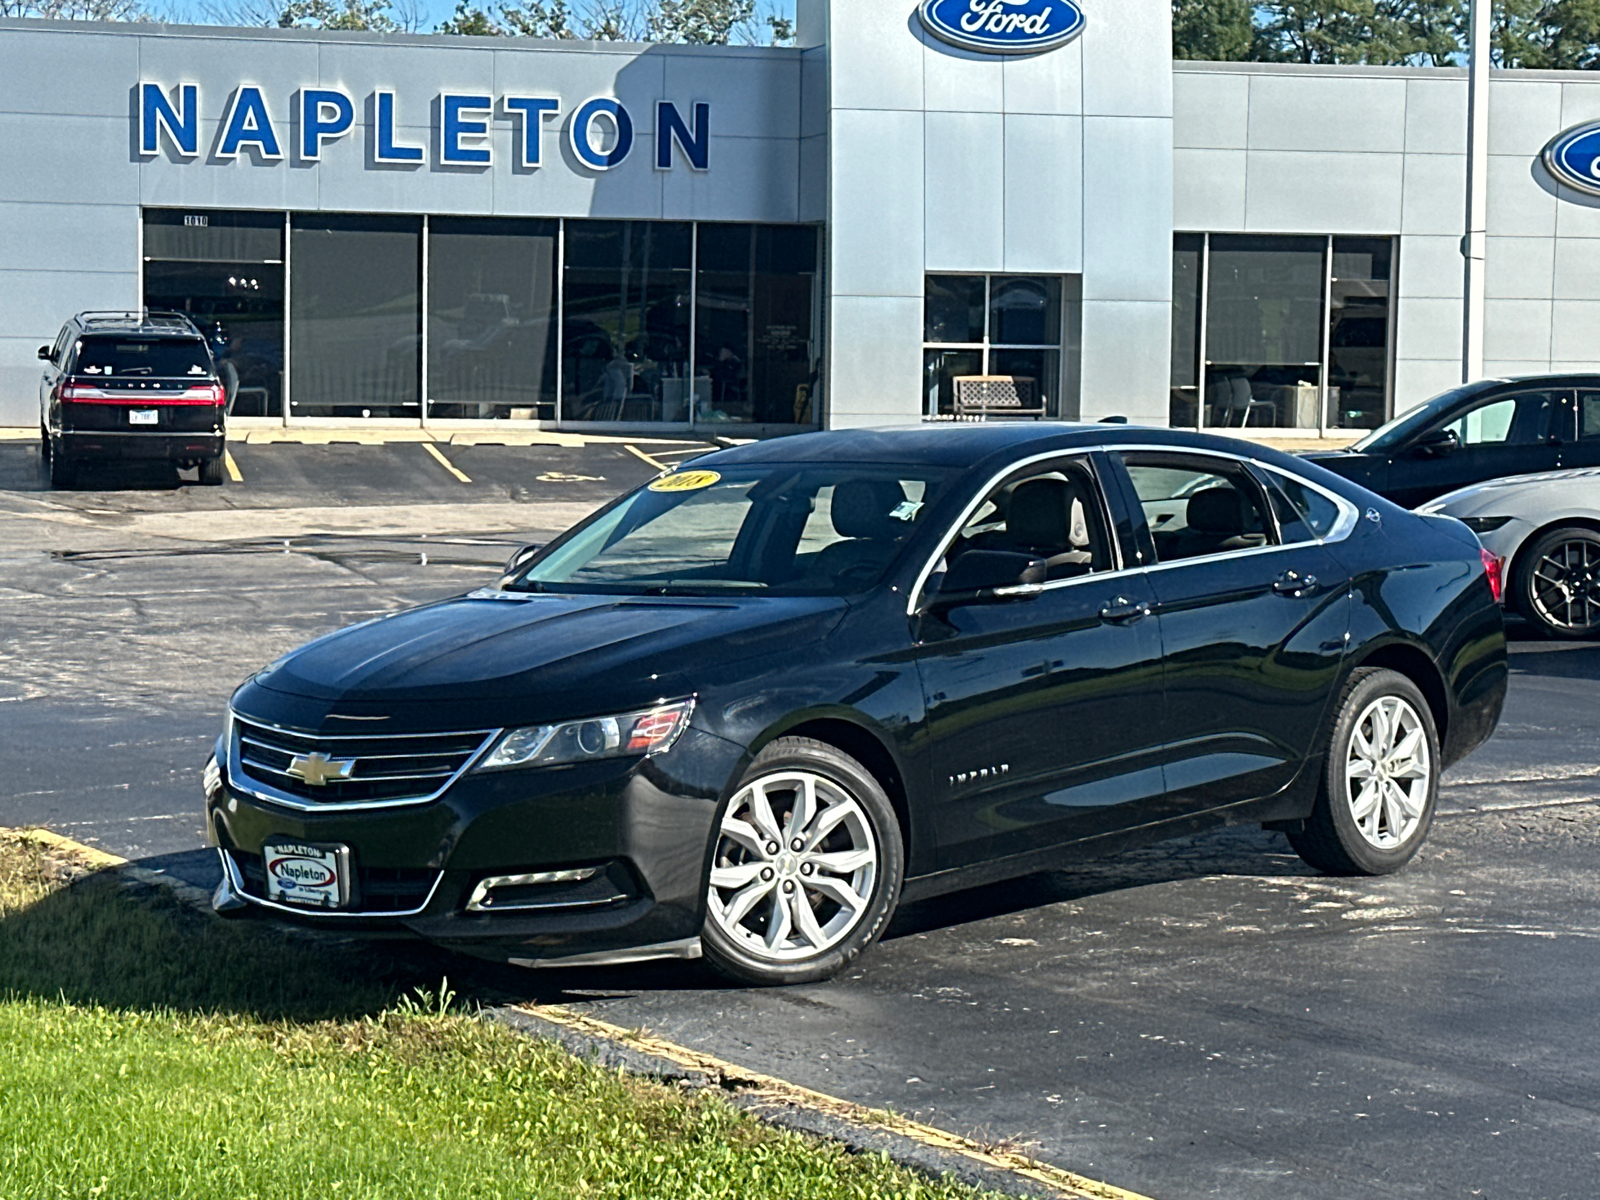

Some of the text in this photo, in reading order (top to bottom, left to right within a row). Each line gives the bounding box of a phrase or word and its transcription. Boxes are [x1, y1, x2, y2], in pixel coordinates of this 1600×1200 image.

[960, 0, 1052, 34] Ford
[138, 80, 710, 172] NAPLETON
[277, 844, 321, 858] NAPLETON
[280, 861, 326, 881] Napleton
